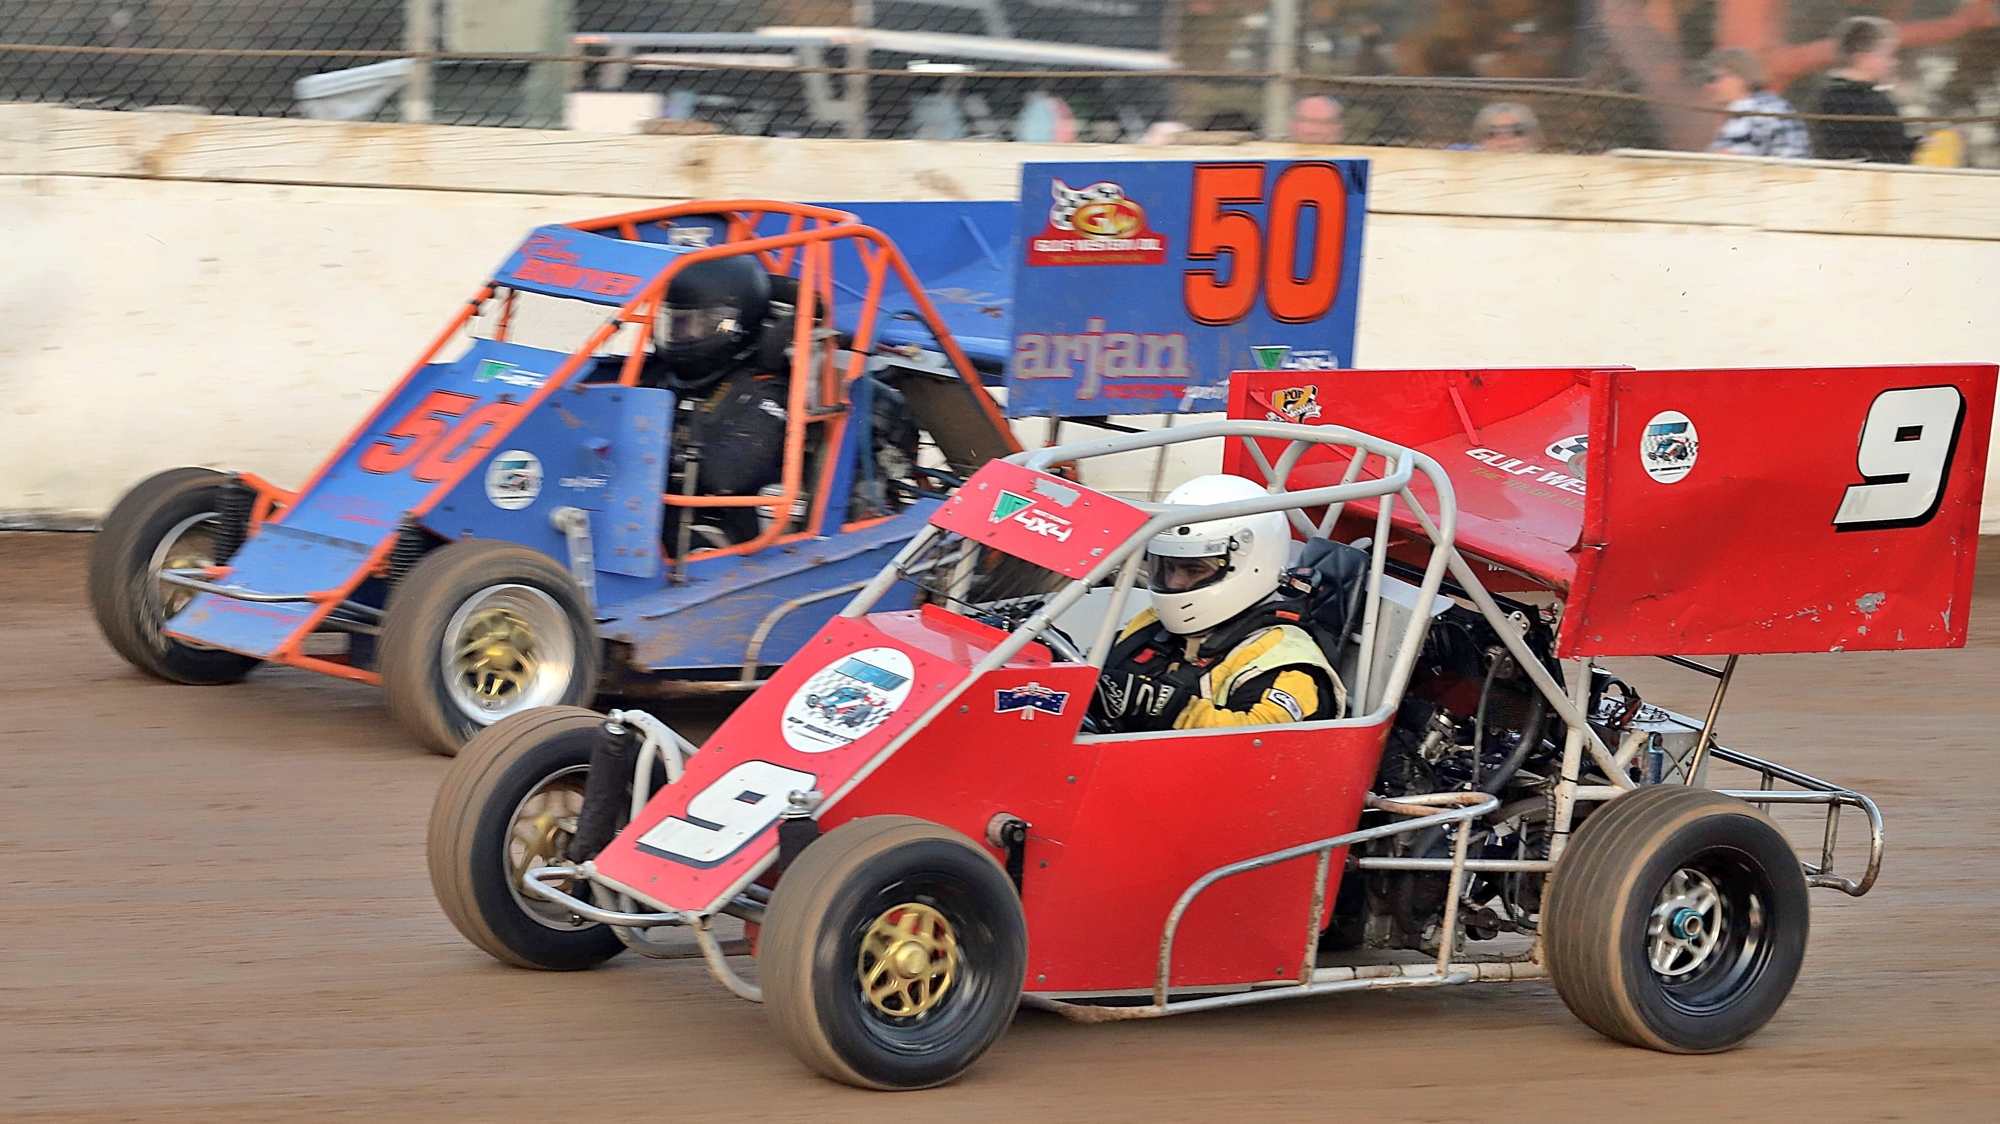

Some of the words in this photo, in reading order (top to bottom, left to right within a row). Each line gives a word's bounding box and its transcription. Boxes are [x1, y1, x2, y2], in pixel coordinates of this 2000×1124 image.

[1182, 161, 1348, 327] 50
[1014, 317, 1191, 400] arjan
[358, 388, 526, 484] 50
[1465, 448, 1545, 476] GULF
[1831, 384, 1967, 533] 9
[634, 759, 817, 870] 9
